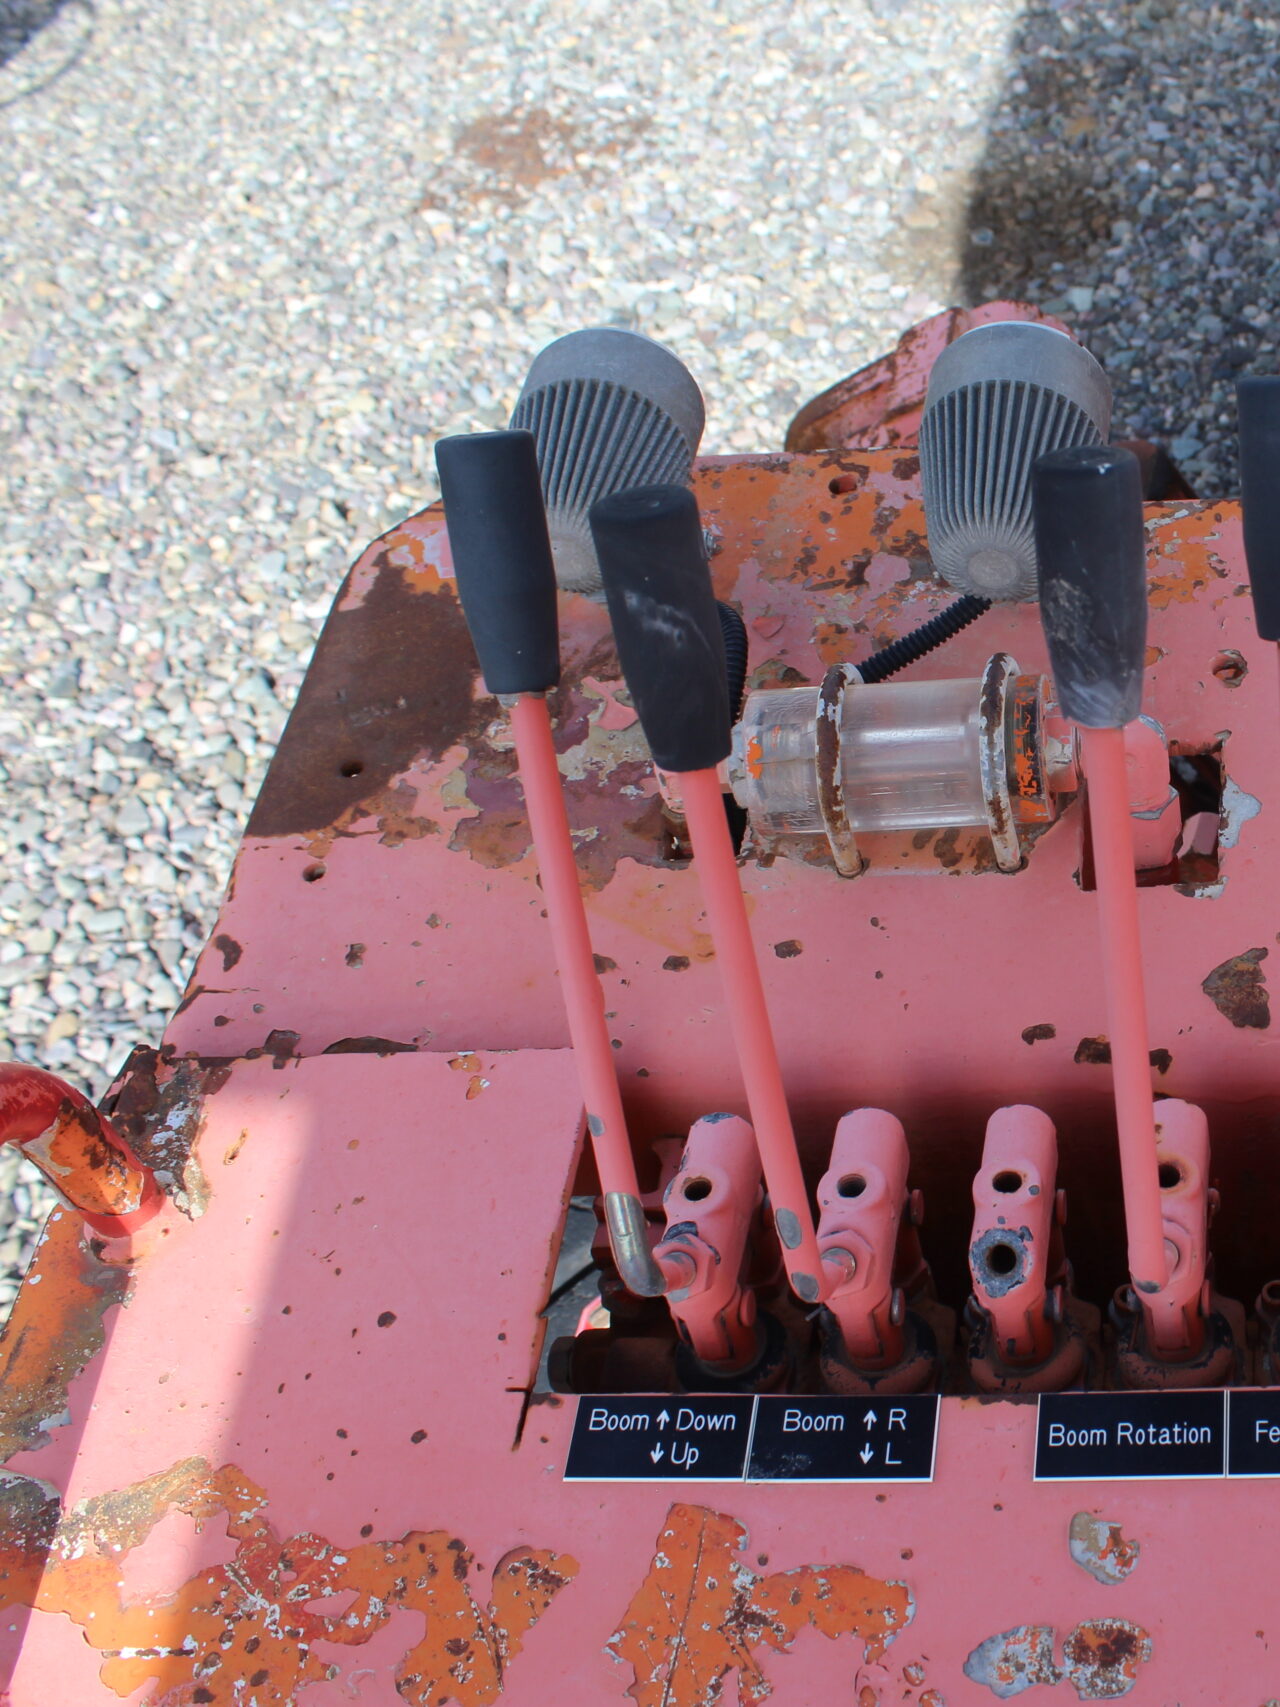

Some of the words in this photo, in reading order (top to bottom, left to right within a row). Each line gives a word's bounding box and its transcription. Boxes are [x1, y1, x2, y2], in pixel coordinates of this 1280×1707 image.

[588, 1407, 650, 1431] Boom
[675, 1407, 736, 1431] Down
[782, 1408, 845, 1432] Boom
[888, 1407, 907, 1431] R
[1048, 1422, 1107, 1447] Boom
[1117, 1421, 1211, 1445] Rotation
[670, 1440, 699, 1470] Up
[885, 1441, 902, 1465] L
